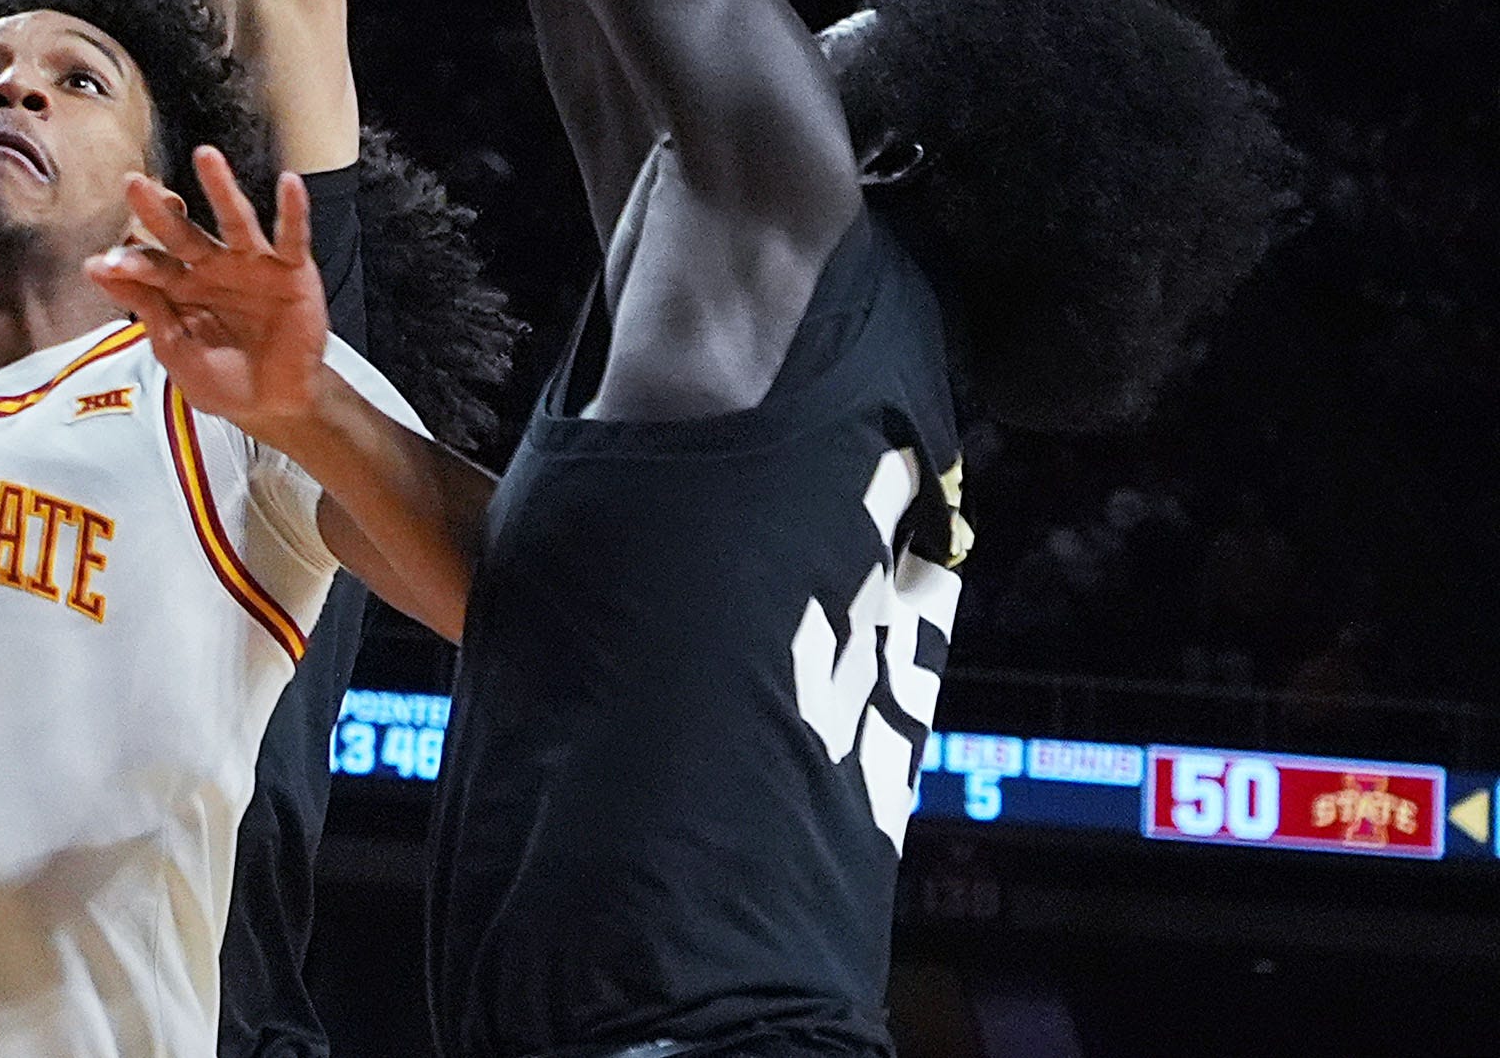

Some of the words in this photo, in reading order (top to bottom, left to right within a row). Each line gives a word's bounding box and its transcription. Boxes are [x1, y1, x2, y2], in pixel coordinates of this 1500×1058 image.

[964, 769, 1002, 821] 5
[1171, 756, 1280, 841] 50
[1311, 789, 1419, 835] STATE
